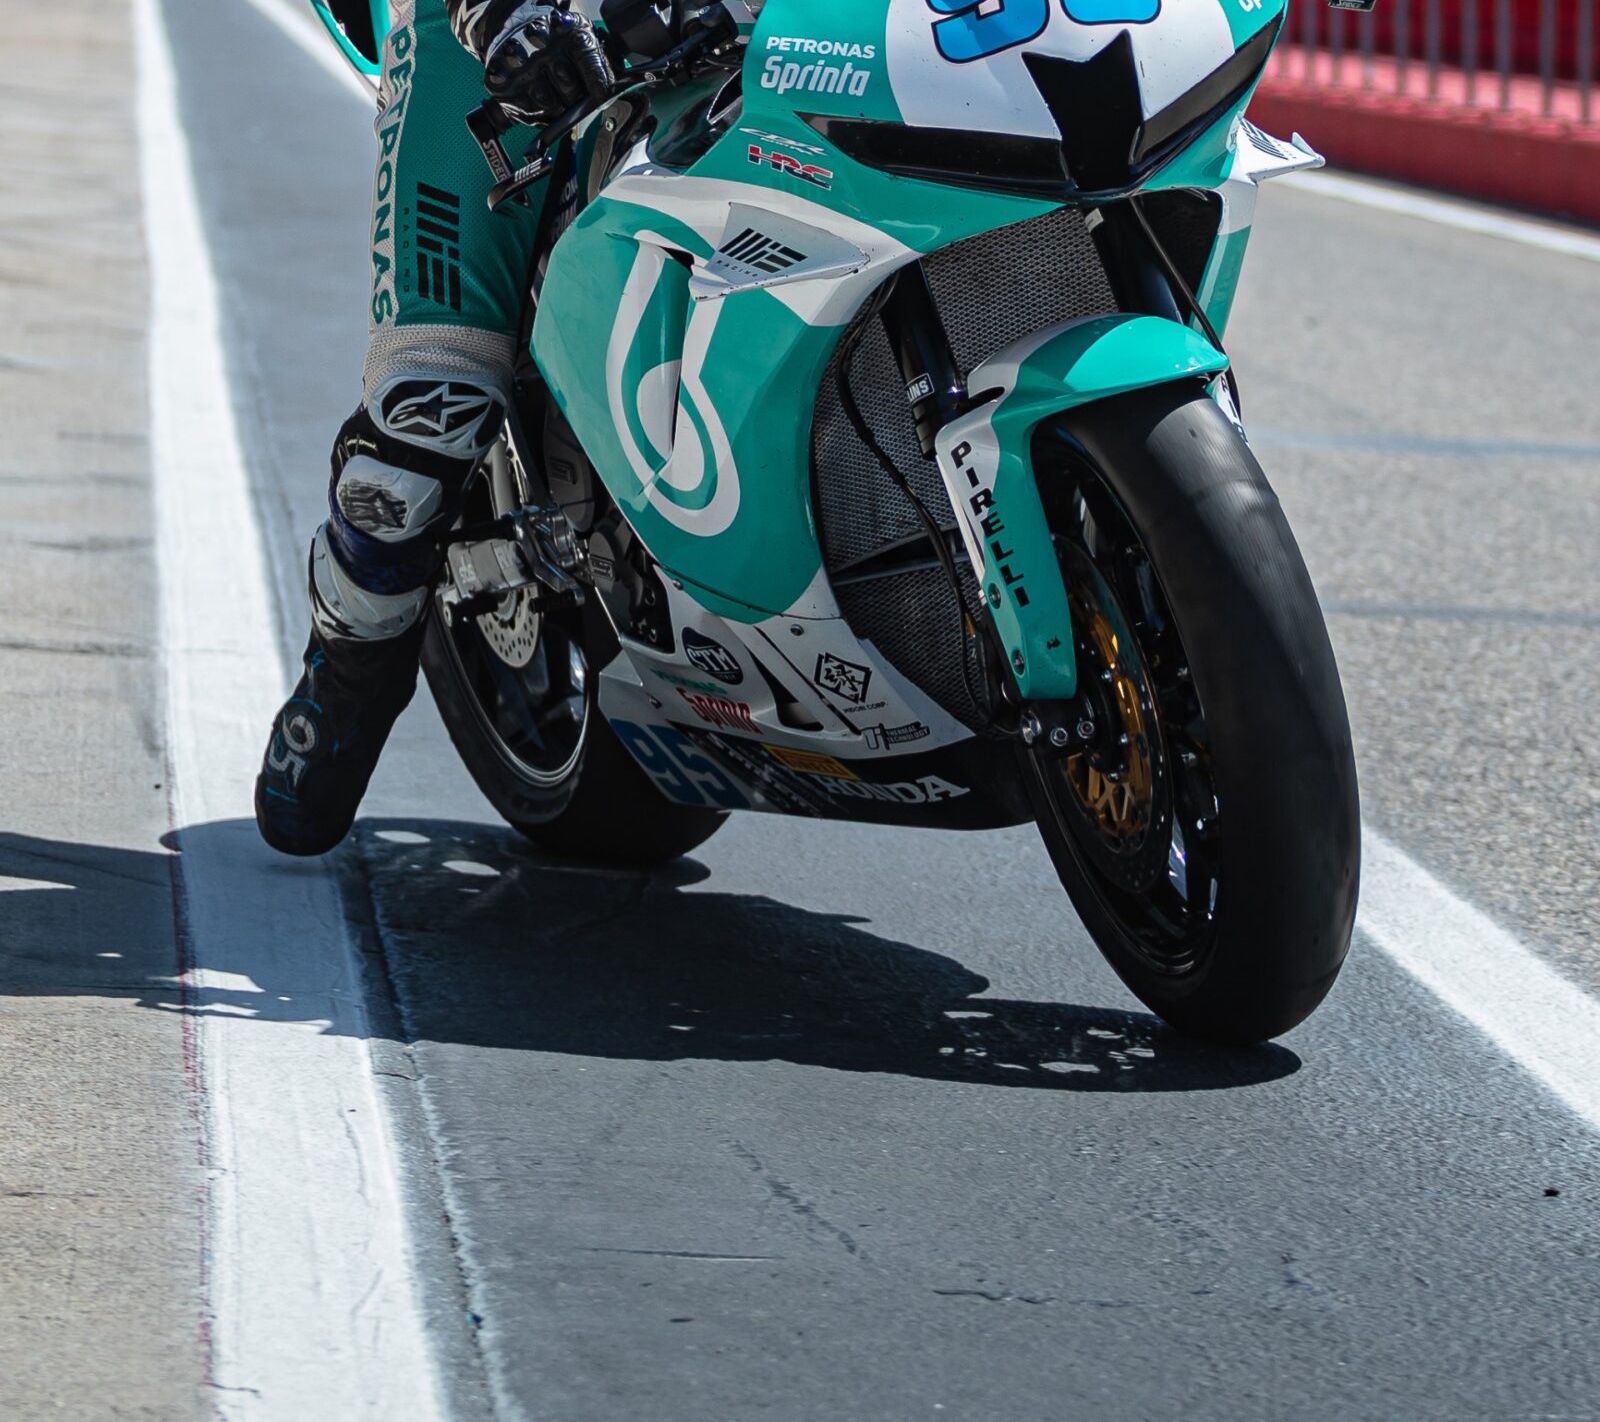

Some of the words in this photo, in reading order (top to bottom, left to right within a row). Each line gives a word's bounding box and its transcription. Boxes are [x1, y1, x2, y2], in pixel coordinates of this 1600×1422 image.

[766, 36, 876, 59] PETRONAS
[760, 55, 871, 97] Sprinta
[371, 25, 413, 325] PETRONAS
[748, 144, 833, 191] HRC
[906, 379, 929, 402] LINS
[951, 440, 1031, 608] PIRELLI
[686, 647, 740, 671] STM
[609, 717, 750, 810] 95
[810, 774, 971, 804] HONDA
